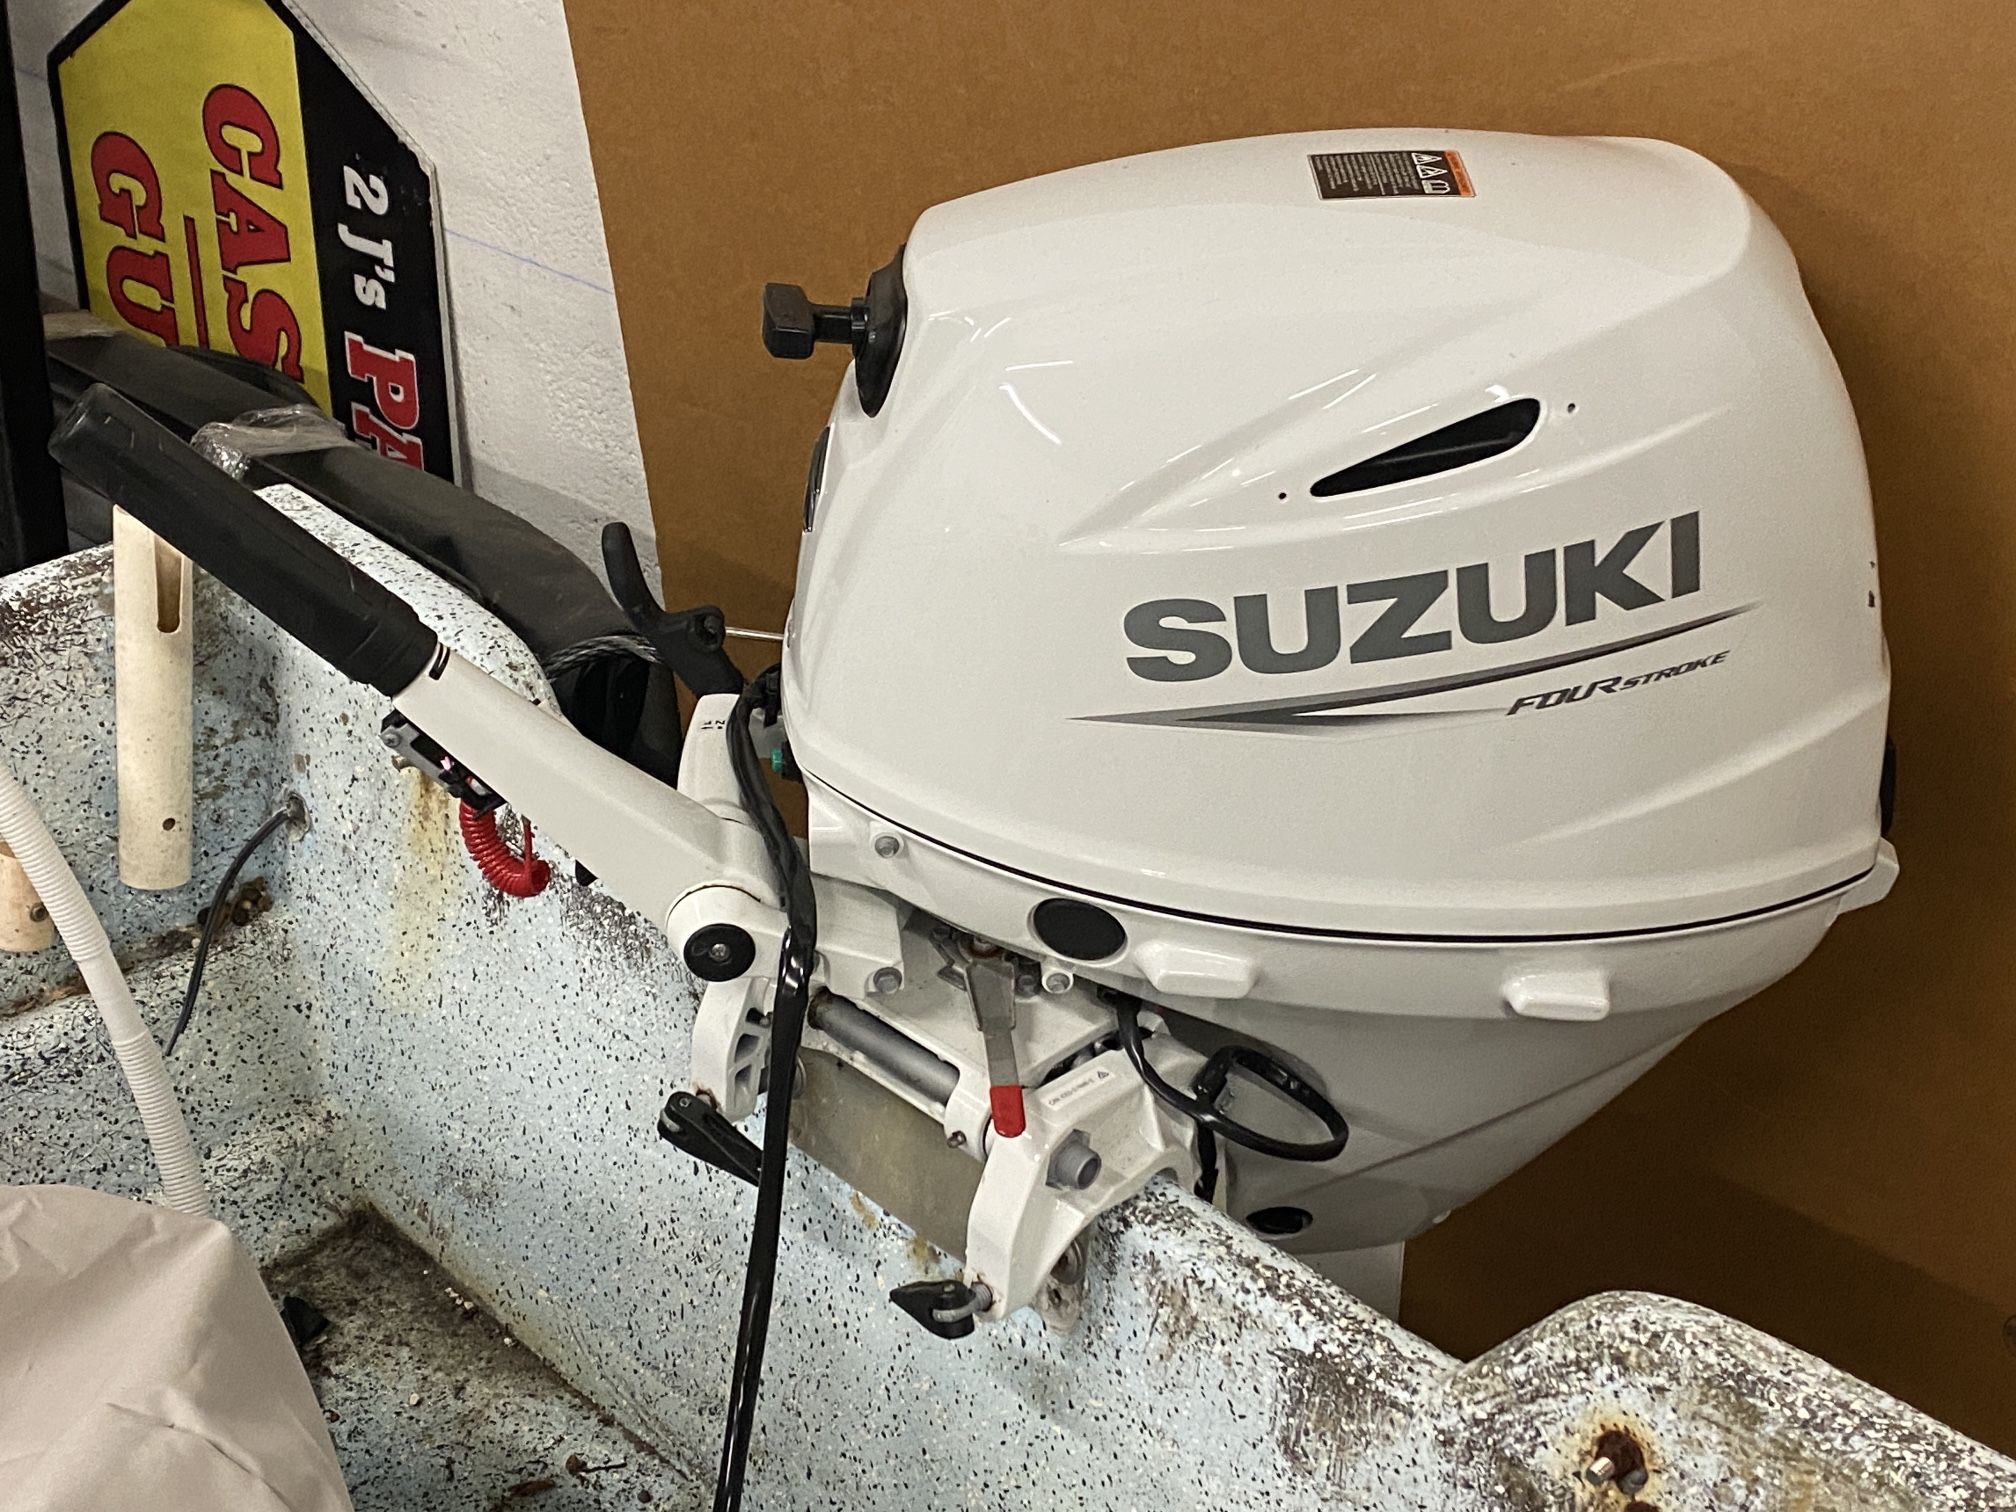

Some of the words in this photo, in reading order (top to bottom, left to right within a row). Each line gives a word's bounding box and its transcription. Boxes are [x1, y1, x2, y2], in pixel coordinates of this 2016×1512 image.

[343, 165, 390, 216] 2
[337, 222, 396, 310] J's
[1124, 511, 1701, 682] SUZUKI
